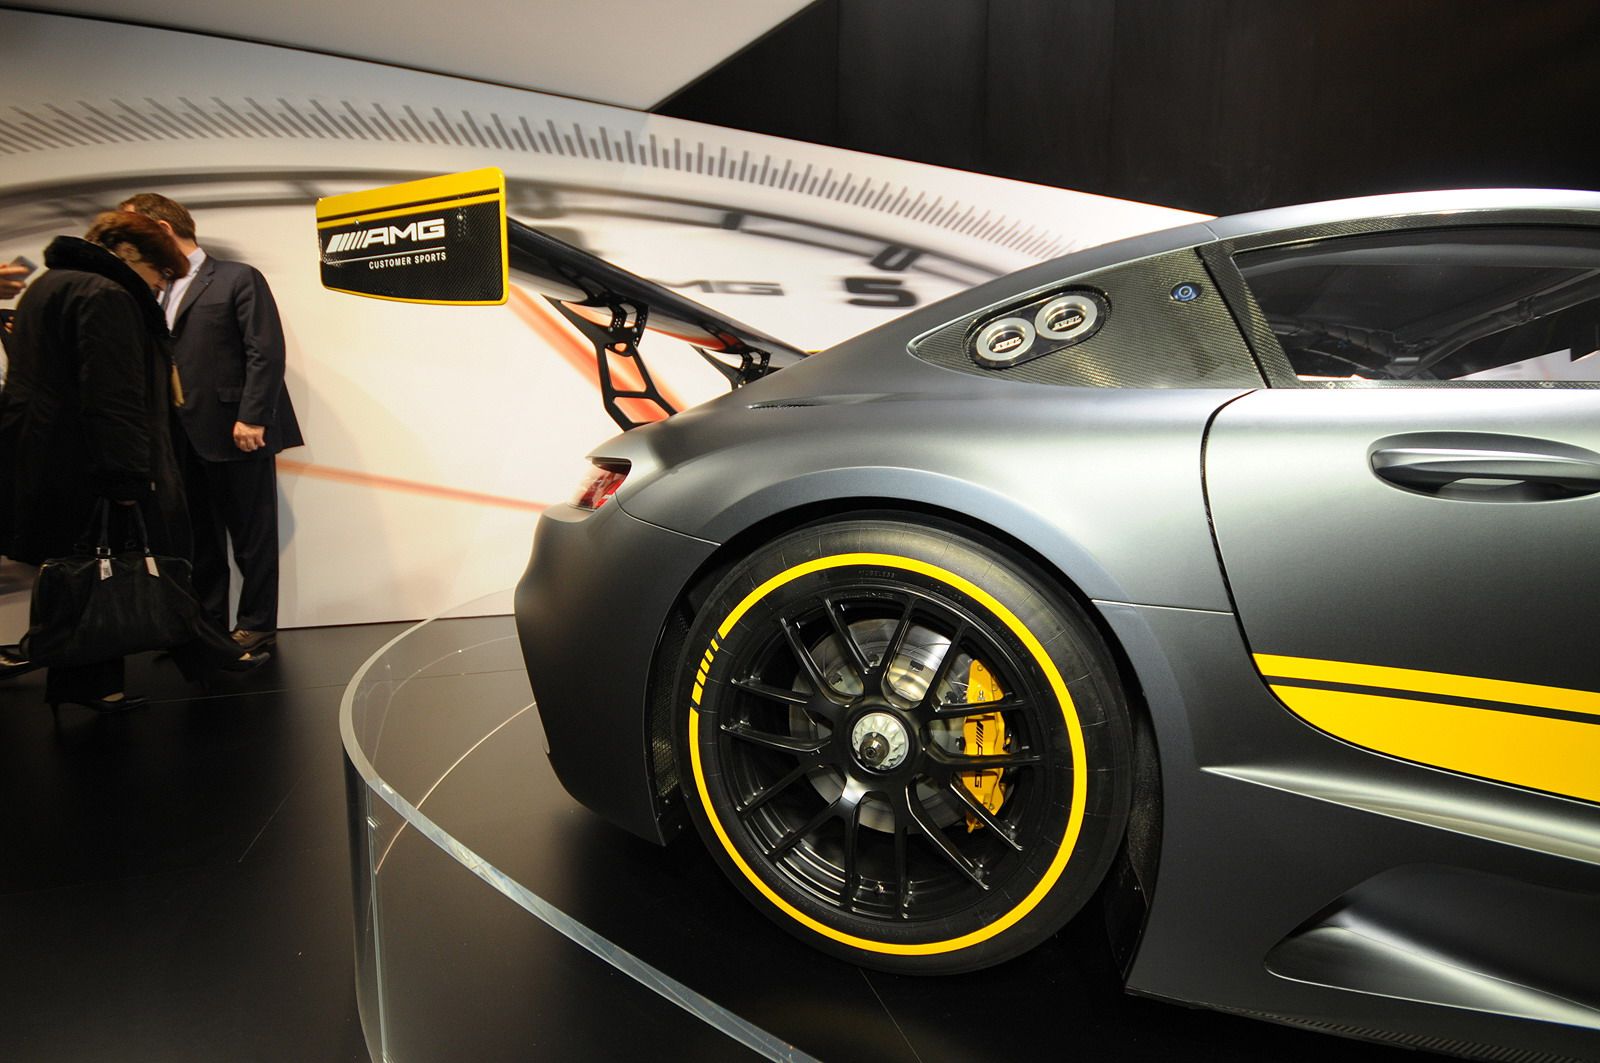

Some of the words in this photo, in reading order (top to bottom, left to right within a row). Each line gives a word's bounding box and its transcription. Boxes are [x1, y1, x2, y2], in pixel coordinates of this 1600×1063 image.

[361, 218, 446, 249] AMG
[368, 256, 412, 270] CUSTOMER
[414, 251, 447, 264] SPORTS
